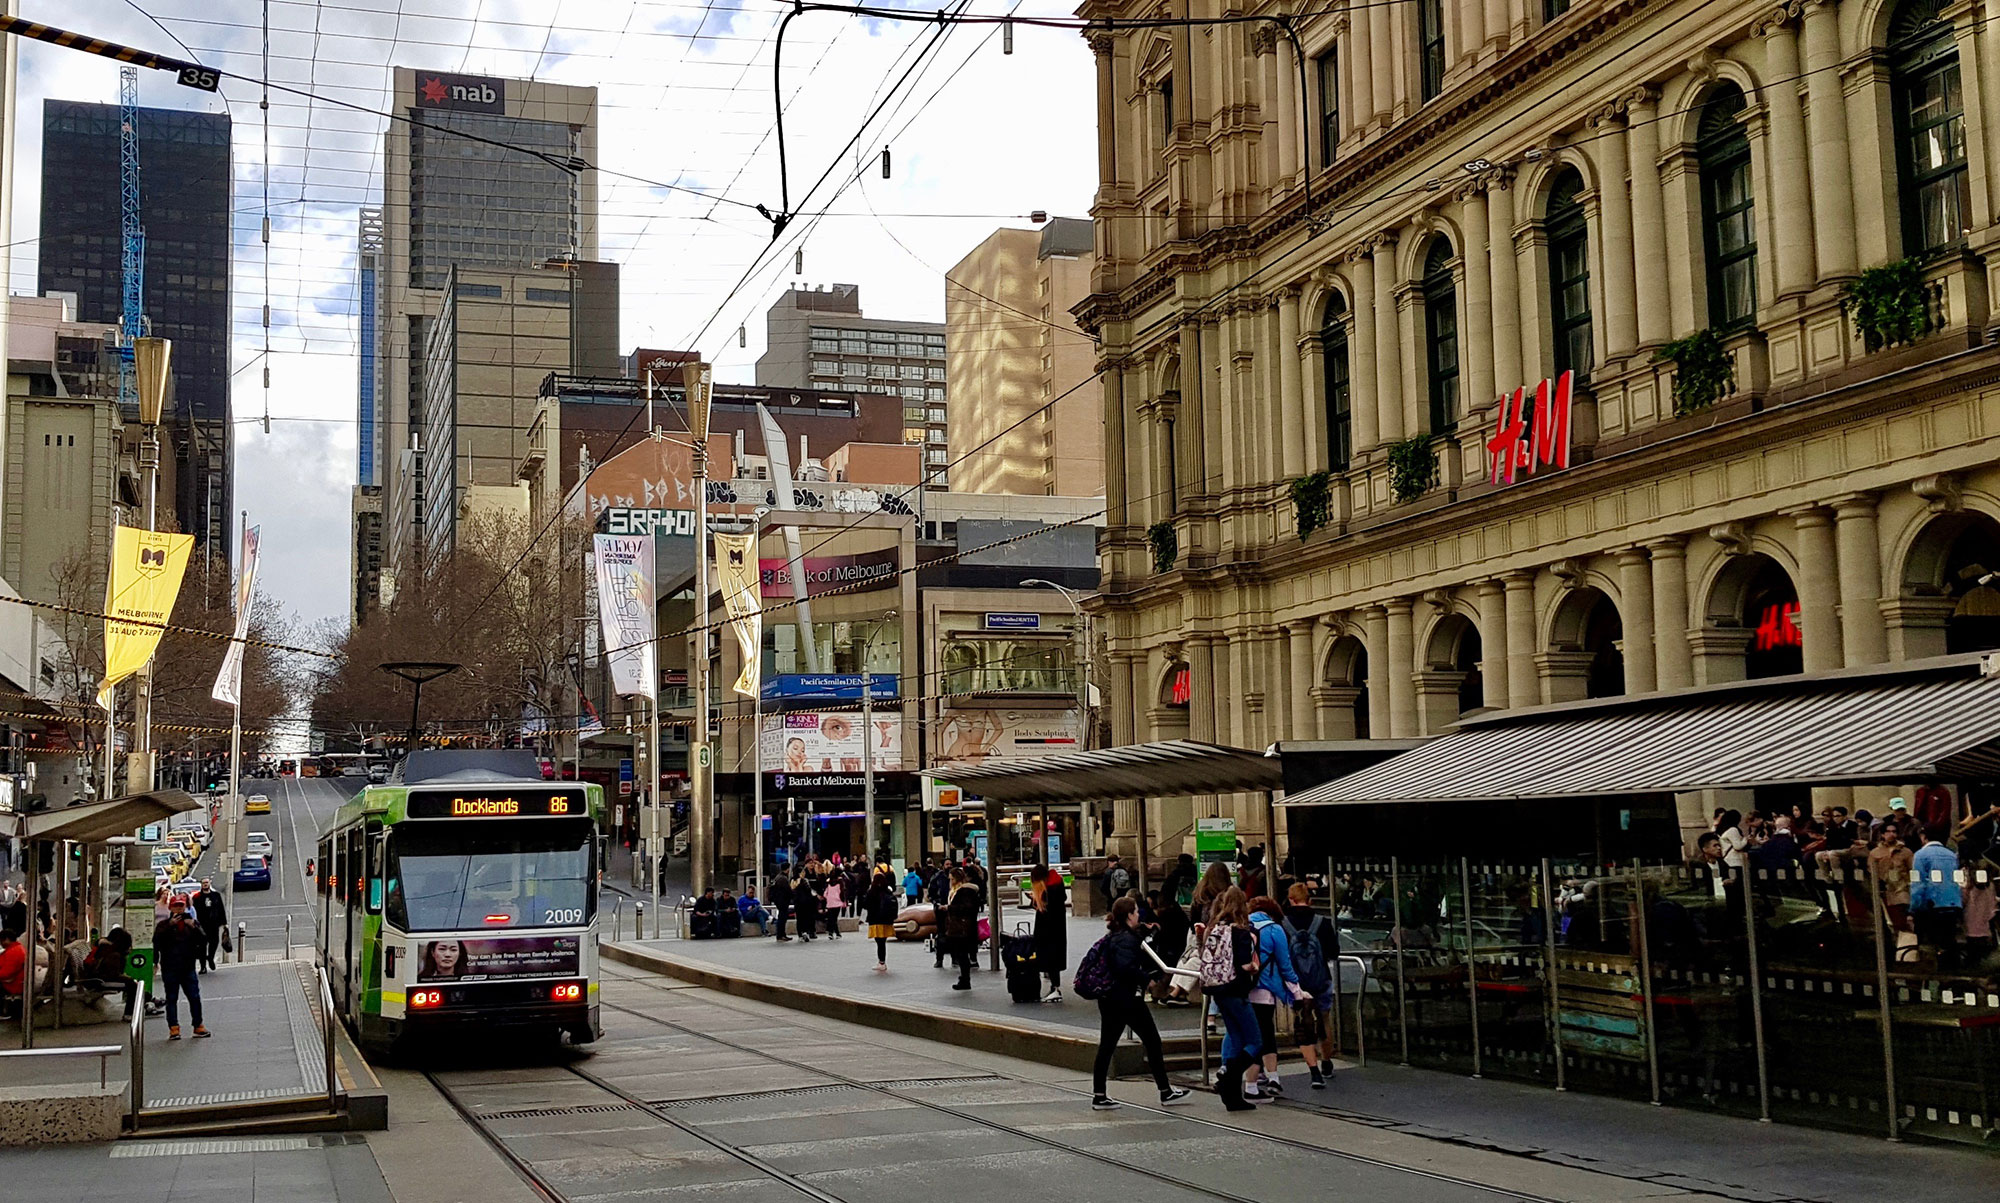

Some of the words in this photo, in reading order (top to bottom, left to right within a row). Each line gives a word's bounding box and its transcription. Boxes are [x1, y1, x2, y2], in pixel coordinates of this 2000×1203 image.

[183, 68, 214, 88] 35
[452, 83, 496, 103] nab
[1486, 369, 1574, 486] H&M
[777, 569, 815, 584] Bak
[817, 567, 834, 582] of
[836, 561, 893, 581] Melbourne
[117, 608, 165, 620] MELBOURNE
[1014, 729, 1032, 737] Body
[1035, 729, 1070, 738] Sculpting
[788, 776, 812, 786] Bank
[812, 776, 821, 785] of
[822, 776, 867, 786] Melbourn
[454, 798, 519, 815] Docklands
[550, 796, 568, 812] 86
[545, 908, 582, 924] 2009
